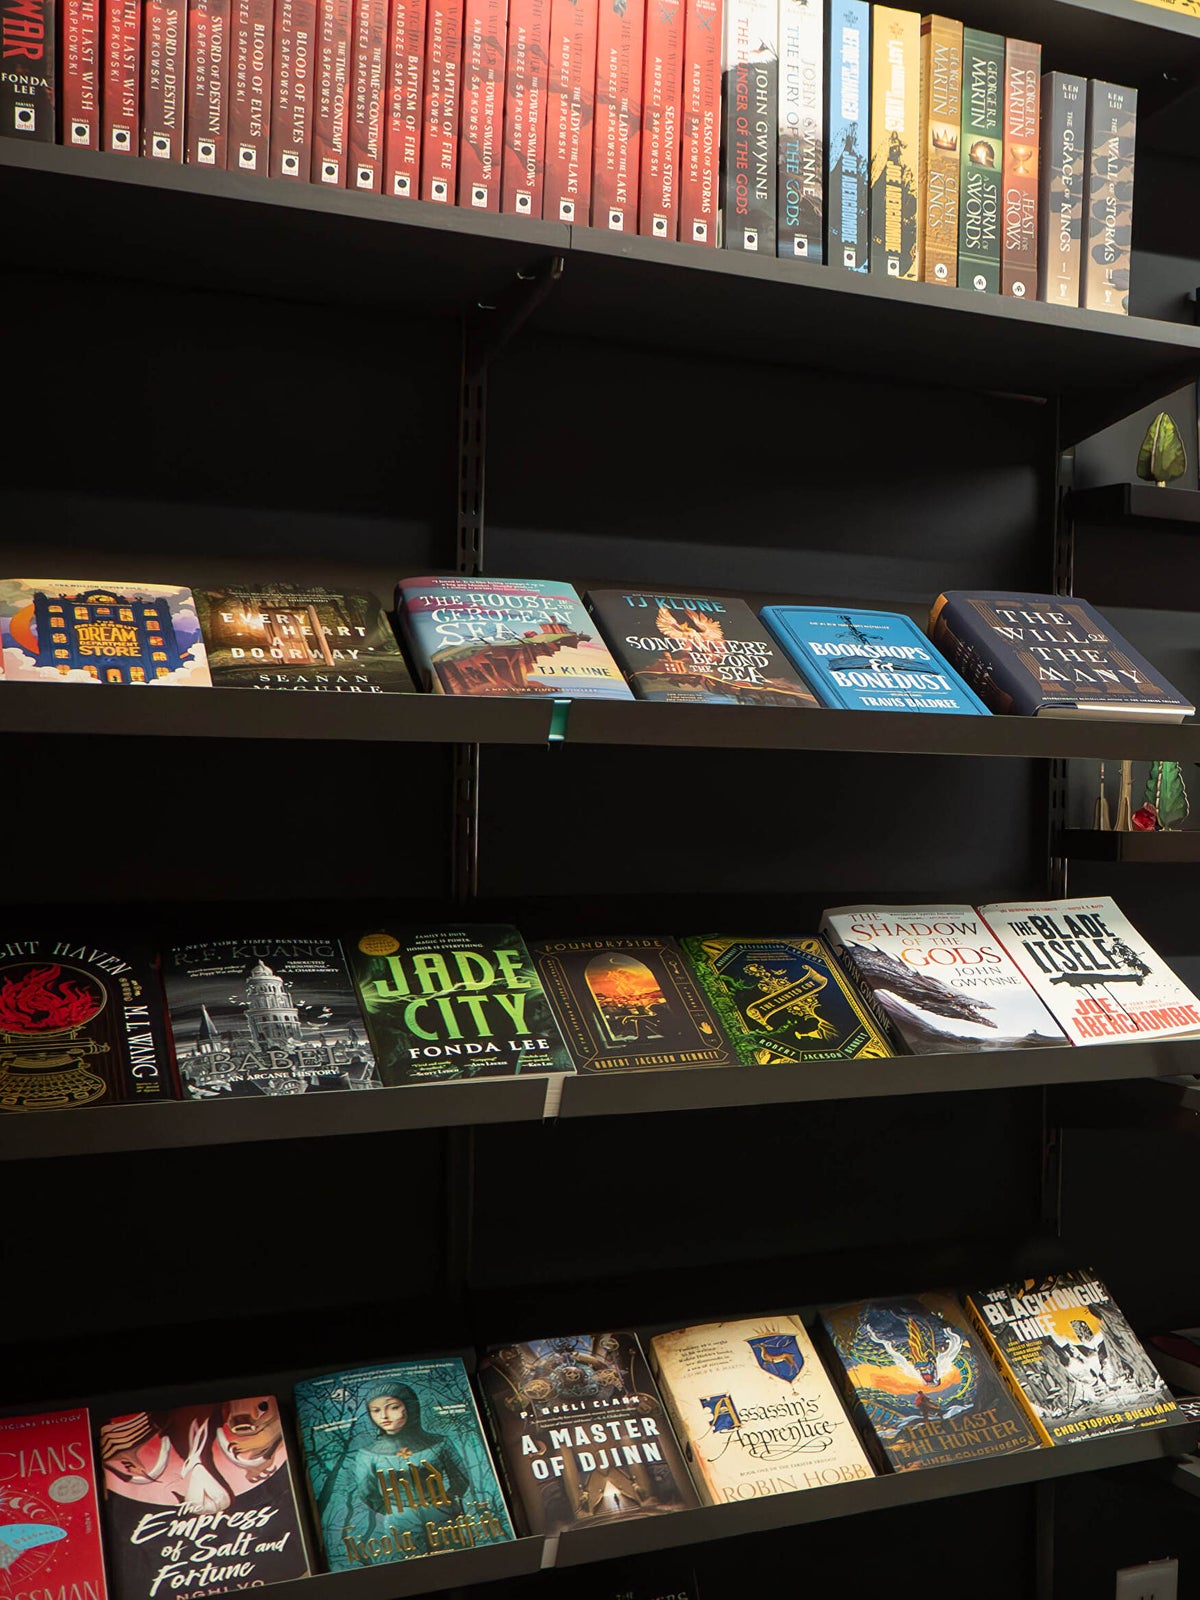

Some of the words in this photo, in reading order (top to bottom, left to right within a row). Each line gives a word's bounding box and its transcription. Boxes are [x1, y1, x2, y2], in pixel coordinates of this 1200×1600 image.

[82, 29, 93, 64] LAST
[165, 9, 177, 57] SWORD
[738, 17, 749, 44] THE
[1, 73, 48, 87] FONDA
[165, 59, 175, 71] OF
[736, 50, 749, 111] HUNGER
[14, 85, 35, 95] LEE
[82, 72, 93, 110] WISH
[653, 57, 662, 107] ANDRZEJ
[756, 67, 768, 116] JOHN
[163, 73, 176, 128] DESTINY
[664, 105, 674, 148] SEASON
[736, 117, 747, 137] OF
[651, 112, 660, 177] SAPKOWSKI
[736, 142, 747, 170] THE
[752, 121, 768, 201] GWYNNE
[1062, 129, 1074, 186] GRACE
[663, 163, 672, 209] STORMS
[736, 175, 747, 215] GODS
[967, 172, 981, 249] SWORDS
[983, 182, 996, 239] STORM
[1060, 202, 1072, 252] KINGS
[220, 612, 308, 626] EVERY
[420, 596, 463, 606] THE
[465, 594, 557, 611] HOUSE
[431, 609, 572, 624] CERULEAN
[995, 610, 1072, 625] THE
[78, 627, 136, 643] DREAM
[272, 636, 282, 647] A
[282, 626, 367, 638] HEART
[433, 623, 520, 648] SEA
[625, 635, 773, 656] SOMEWHERE
[993, 627, 1088, 645] WILL
[78, 646, 142, 657] STORE
[231, 647, 360, 661] DOORWAY
[689, 652, 769, 668] BEYOND
[808, 642, 928, 661] BOOKSHOPS
[259, 673, 370, 684] SEANAN
[689, 665, 714, 673] THE
[720, 666, 771, 685] SEA
[834, 671, 949, 690] BONEDUST
[1038, 666, 1143, 684] MANY
[851, 922, 978, 942] SHADOW
[1007, 919, 1032, 936] THE
[1027, 912, 1114, 939] BLADE
[53, 941, 133, 976] HAVEN
[232, 946, 335, 958] KUANG
[900, 947, 1002, 967] GODS
[1022, 938, 1120, 974] ITSELF
[373, 950, 531, 998] JADE
[403, 993, 531, 1041] CITY
[1075, 998, 1117, 1015] JOE
[127, 1032, 159, 1079] WANG
[208, 1048, 352, 1075] BABEL
[227, 1074, 242, 1082] AN
[247, 1071, 285, 1081] ARCANE
[290, 1068, 339, 1077] HISTORY
[982, 1281, 1108, 1326] BLACKTONGUE
[1010, 1315, 1056, 1341] THIEF
[699, 1392, 822, 1440] Assassin's
[906, 1421, 945, 1442] THE
[953, 1409, 998, 1430] LAST
[1053, 1415, 1124, 1436] CHRISTOPHER
[1126, 1402, 1177, 1420] BUEHLMAN
[521, 1434, 541, 1455] A
[549, 1418, 660, 1450] MASTER
[707, 1415, 844, 1463] Apprentice
[901, 1439, 938, 1460] PHI
[941, 1425, 1020, 1451] HUNTER
[531, 1458, 565, 1481] OF
[580, 1443, 663, 1472] DJINN
[377, 1458, 452, 1515] Hild
[722, 1474, 797, 1503] ROBIN
[805, 1463, 867, 1488] HOBB
[130, 1505, 279, 1545] Empress
[342, 1519, 416, 1563] Nicola
[424, 1510, 505, 1553] Griffith
[161, 1542, 186, 1561] of
[190, 1535, 251, 1563] Salt
[254, 1532, 291, 1552] and
[148, 1560, 256, 1597] Fortune
